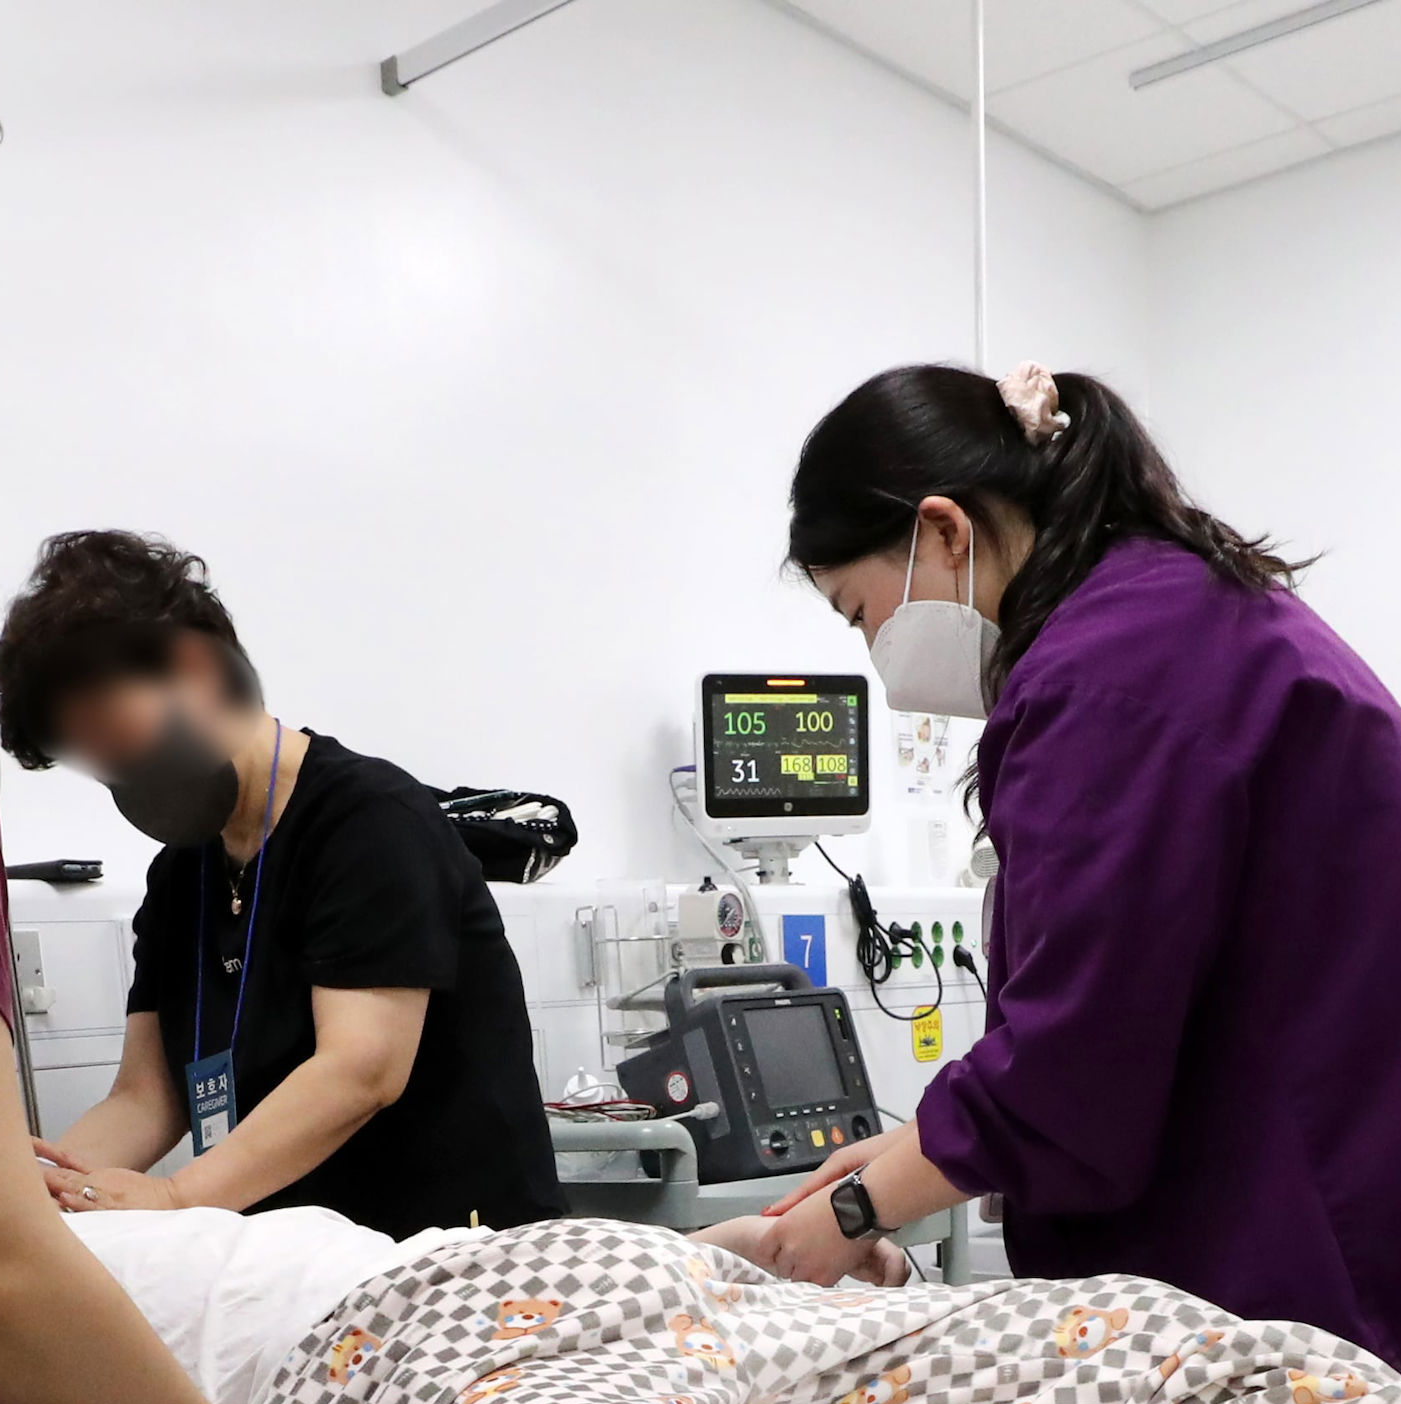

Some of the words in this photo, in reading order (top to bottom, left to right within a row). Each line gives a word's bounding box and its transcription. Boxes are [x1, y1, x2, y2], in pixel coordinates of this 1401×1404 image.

[724, 711, 767, 735] 105
[795, 711, 834, 732] 100
[731, 759, 761, 783] 31
[800, 934, 813, 968] 7
[195, 1073, 228, 1099] 보호자
[196, 1095, 228, 1114] CAREGIVER
